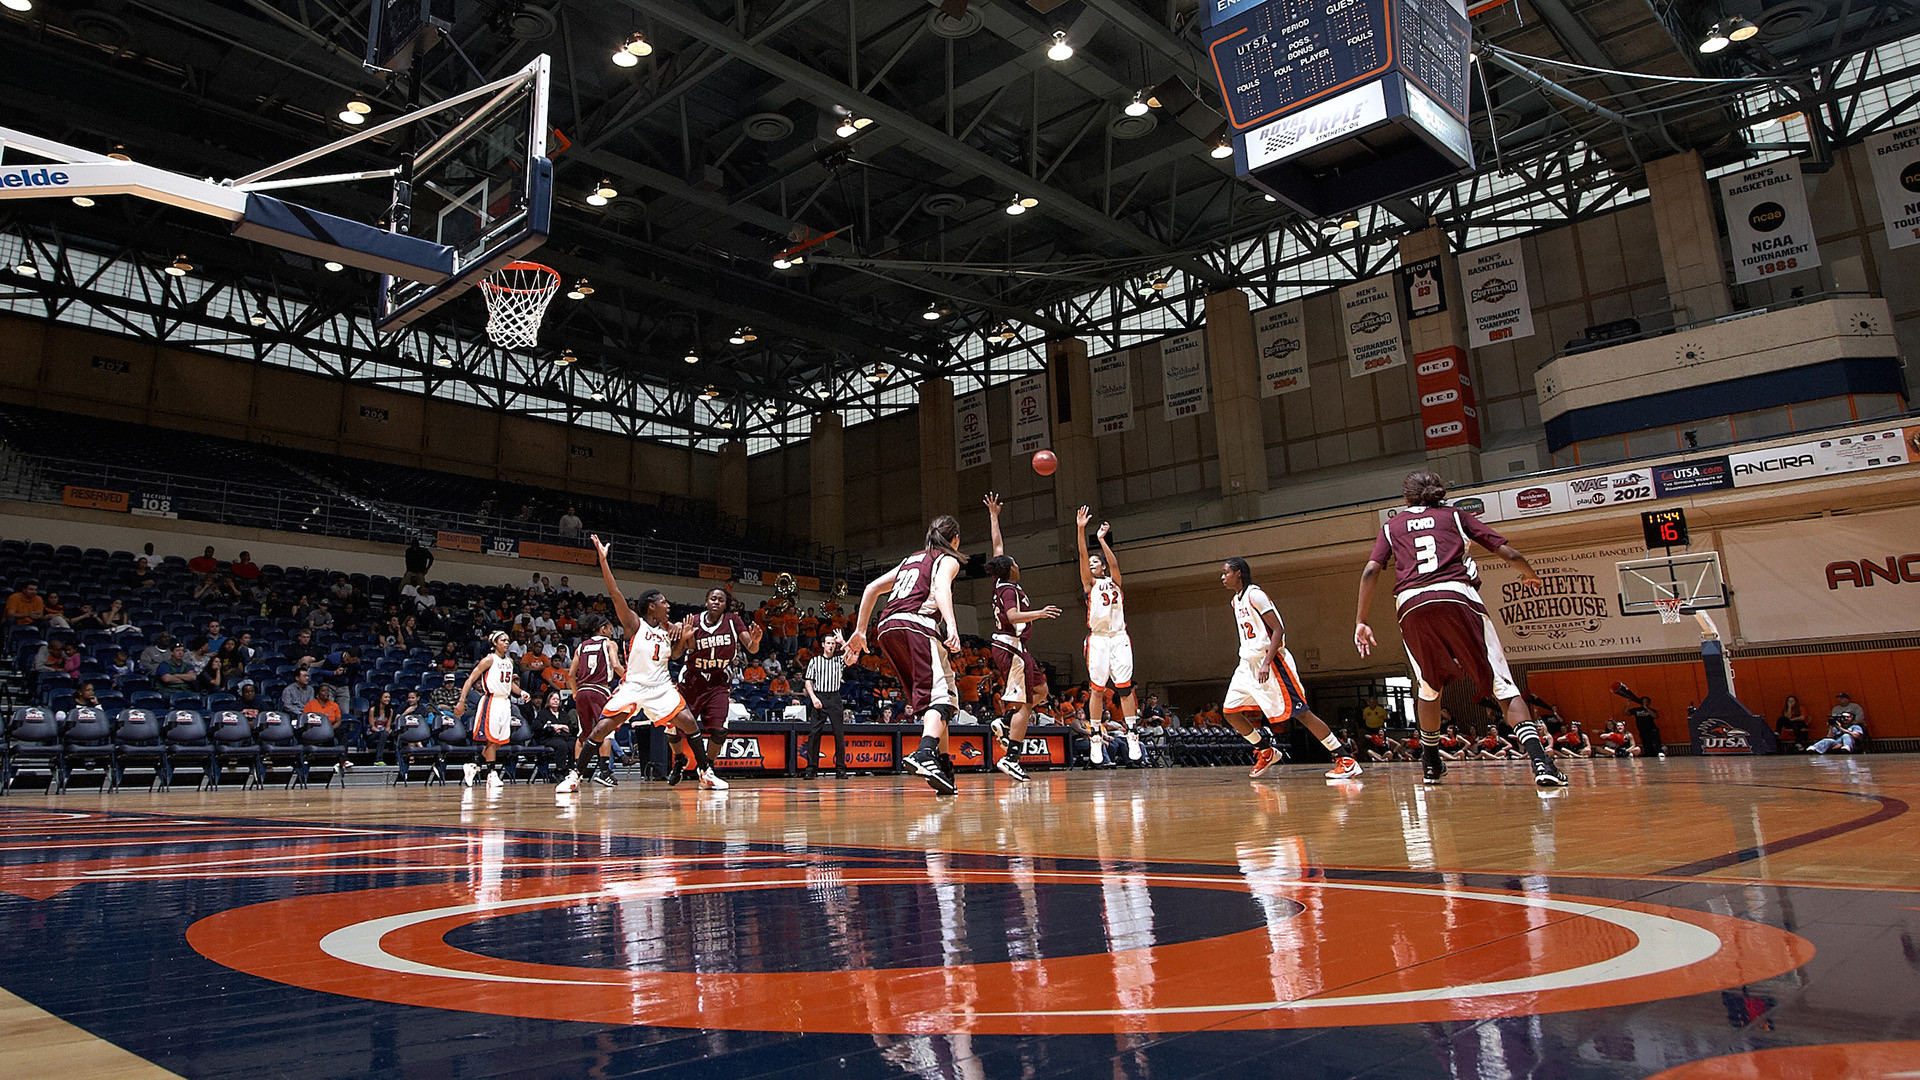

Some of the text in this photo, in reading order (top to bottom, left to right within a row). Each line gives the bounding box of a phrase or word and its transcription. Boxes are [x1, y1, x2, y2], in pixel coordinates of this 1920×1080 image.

[1281, 18, 1310, 36] PERIOD
[1347, 30, 1374, 46] FOULS
[1237, 36, 1269, 56] UTSA
[1287, 44, 1314, 61] BONUS
[1300, 48, 1330, 66] PLAYER
[1274, 65, 1293, 78] FOUL
[1236, 79, 1260, 94] FOULS
[0, 168, 69, 187] elde
[1743, 168, 1774, 183] MEN'S
[1729, 173, 1793, 197] BASKETBALL
[1753, 209, 1782, 224] ncaa
[1751, 234, 1794, 254] NCAA
[1477, 252, 1502, 265] MEN'S
[1741, 243, 1810, 267] TOURNAMENT
[1405, 260, 1437, 274] BROWN
[1468, 258, 1514, 276] BASKETBALL
[1356, 286, 1377, 298] MEN'S
[1346, 292, 1389, 309] BASKETBALL
[1269, 311, 1288, 321] MEN'S
[1476, 308, 1521, 324] TOURNAMENT
[1479, 316, 1520, 331] CHAMPIONS
[1260, 317, 1299, 333] BASKETBALL
[1164, 341, 1199, 355] BASKETBALL
[1353, 337, 1398, 354] TOURNAMENT
[1355, 345, 1397, 360] CHAMPIONS
[1266, 366, 1303, 380] CHAMPIONS
[1166, 387, 1203, 400] TOURNAMENT
[1733, 454, 1815, 476] ANCIRA
[1570, 477, 1609, 493] WAC
[1612, 476, 1639, 488] UTSA
[70, 488, 122, 503] RESERVED
[142, 492, 172, 500] SECTION
[1613, 486, 1650, 502] 2012
[142, 499, 171, 512] 108
[1406, 516, 1435, 532] FORD
[1649, 511, 1680, 523] 11:44
[1660, 522, 1678, 541] 16
[493, 541, 513, 552] 107
[1599, 545, 1645, 558] BANQUETS
[1414, 535, 1439, 574] 3
[743, 571, 759, 580] 106
[1535, 567, 1560, 576] THE
[1501, 575, 1598, 603] SPAGHETTI
[1101, 591, 1119, 606] 32
[1499, 597, 1608, 626] WAREHOUSE
[1524, 620, 1587, 631] RESTAURANT
[696, 634, 731, 650] TEXAS
[1503, 643, 1551, 654] ORDERING
[1620, 636, 1642, 645] 1114
[652, 644, 660, 661] 1
[695, 658, 729, 669] STATE
[500, 671, 511, 683] 15
[1704, 737, 1749, 749] UTSA
[855, 752, 892, 763] 458-UTSA
